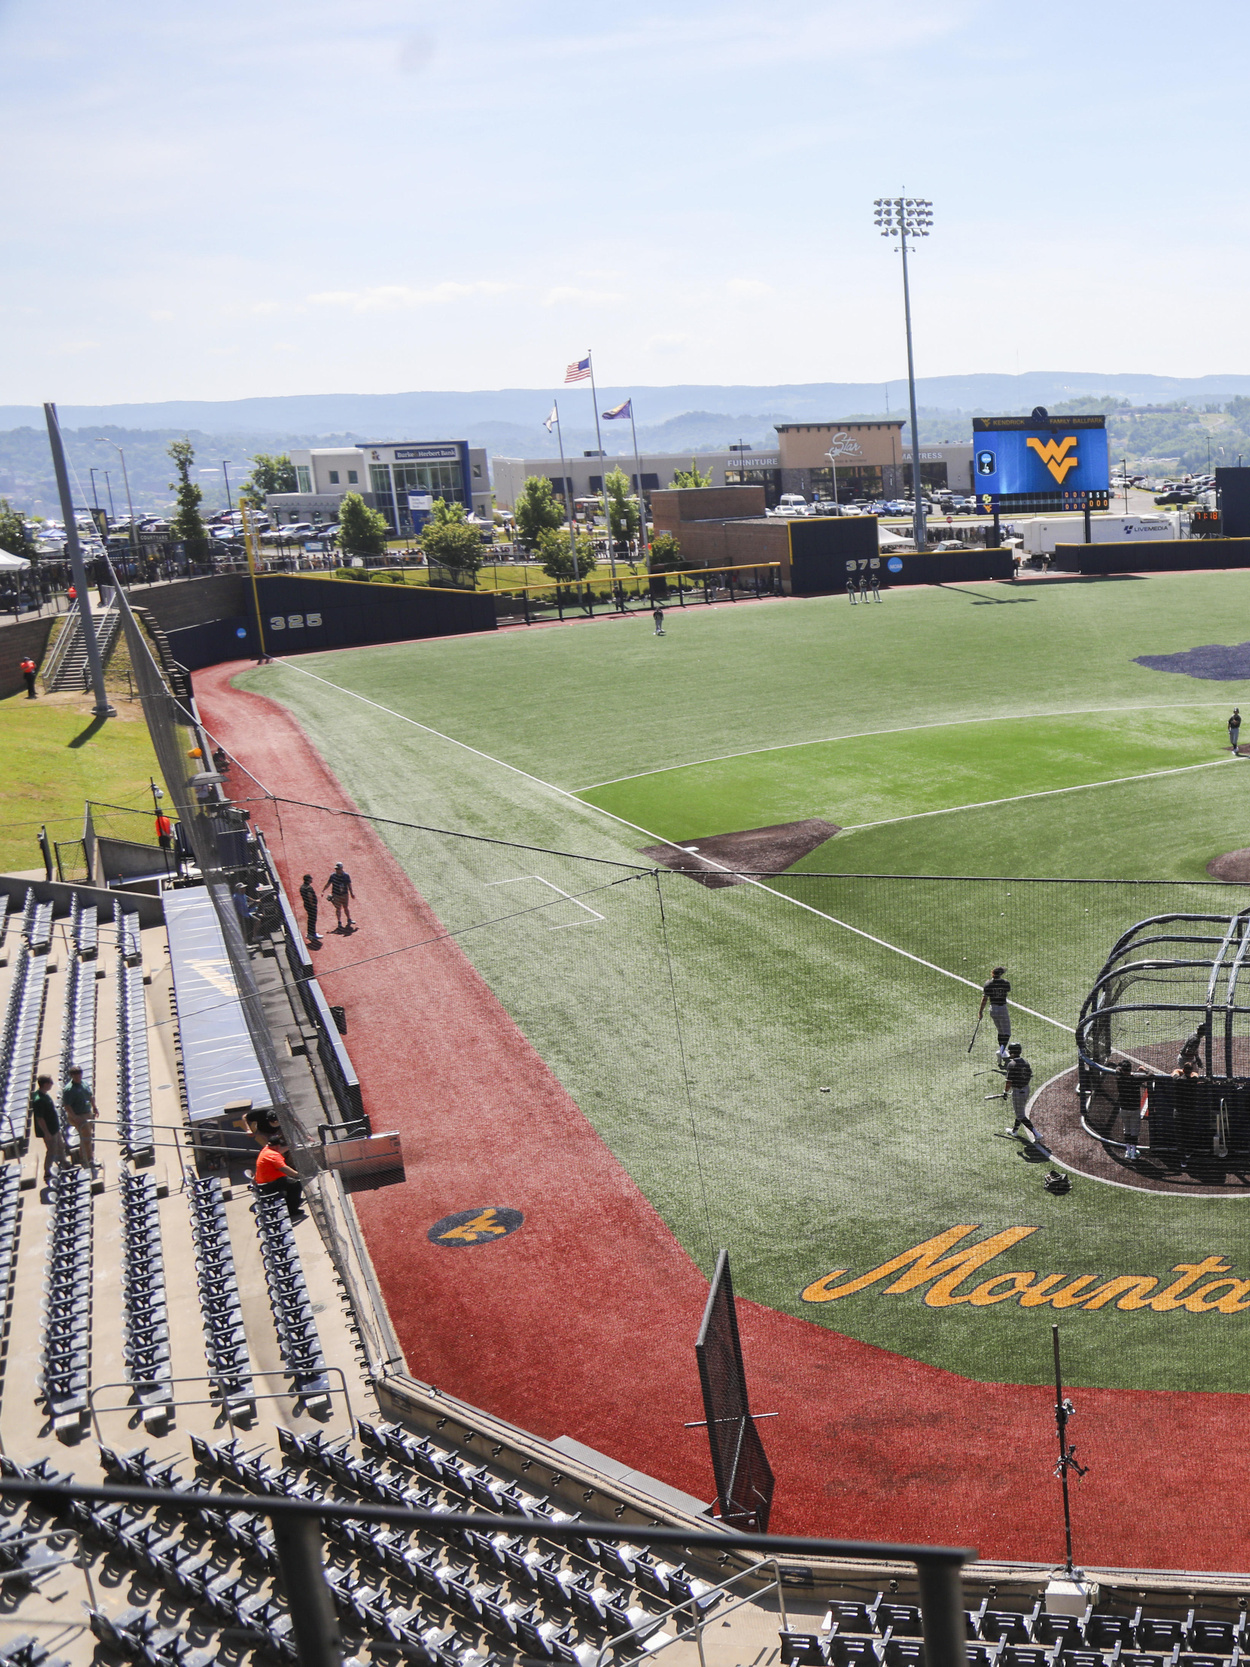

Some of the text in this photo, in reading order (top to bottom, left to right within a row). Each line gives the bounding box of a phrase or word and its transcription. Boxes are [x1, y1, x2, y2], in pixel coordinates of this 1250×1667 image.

[1049, 417, 1071, 425] FAMILY
[1072, 416, 1104, 424] BALLPARK
[727, 458, 778, 467] FURNITURE
[846, 557, 880, 571] 375
[270, 612, 322, 630] 325
